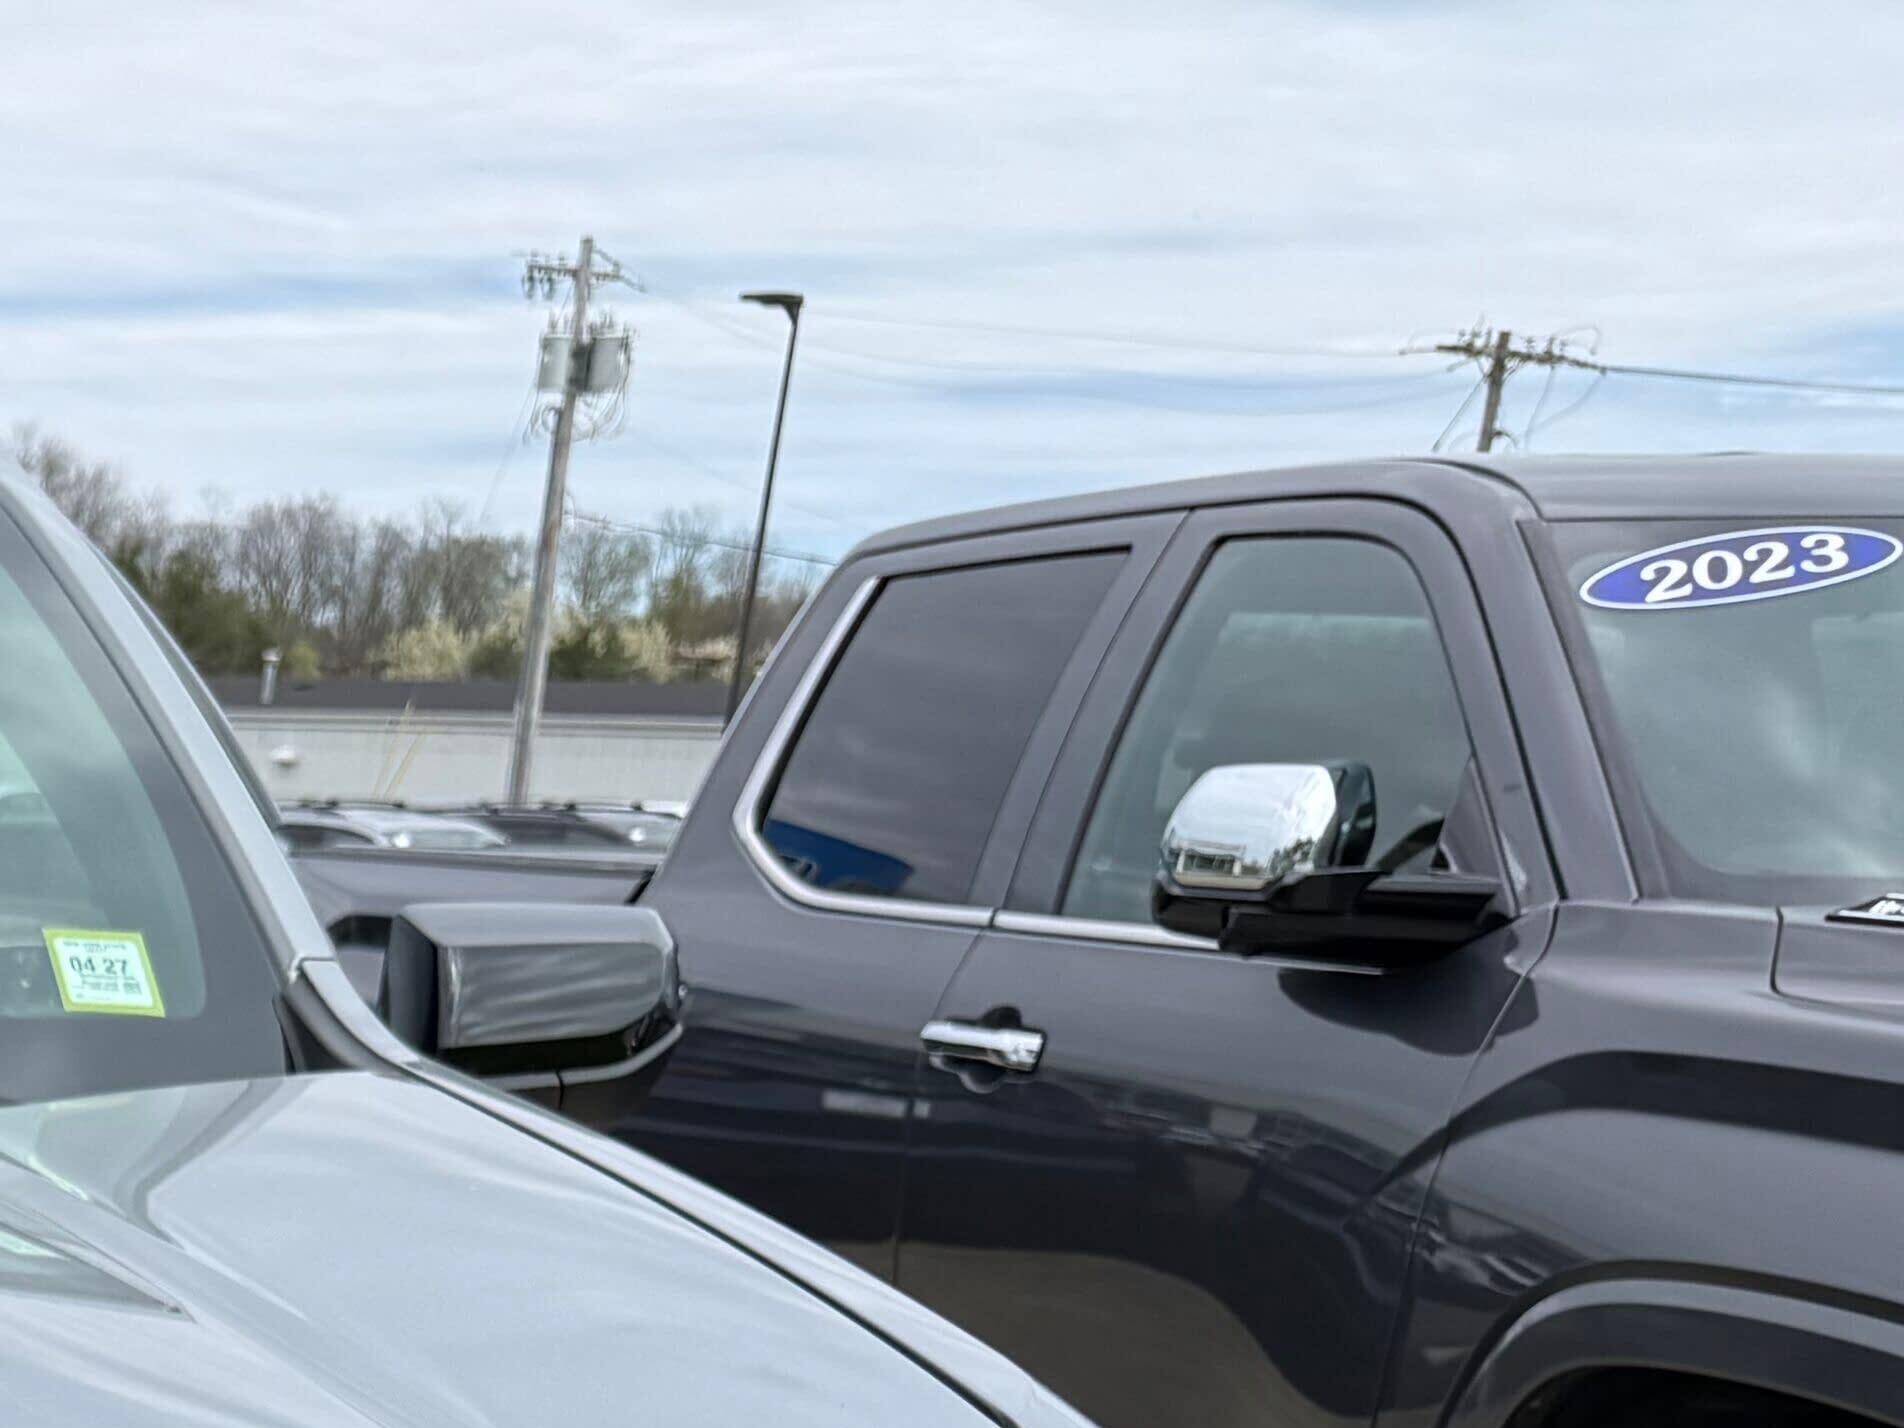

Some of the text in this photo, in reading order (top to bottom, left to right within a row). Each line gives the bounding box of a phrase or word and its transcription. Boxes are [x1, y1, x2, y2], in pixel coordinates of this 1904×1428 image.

[1639, 532, 1850, 604] 2023
[69, 955, 130, 977] 04 27
